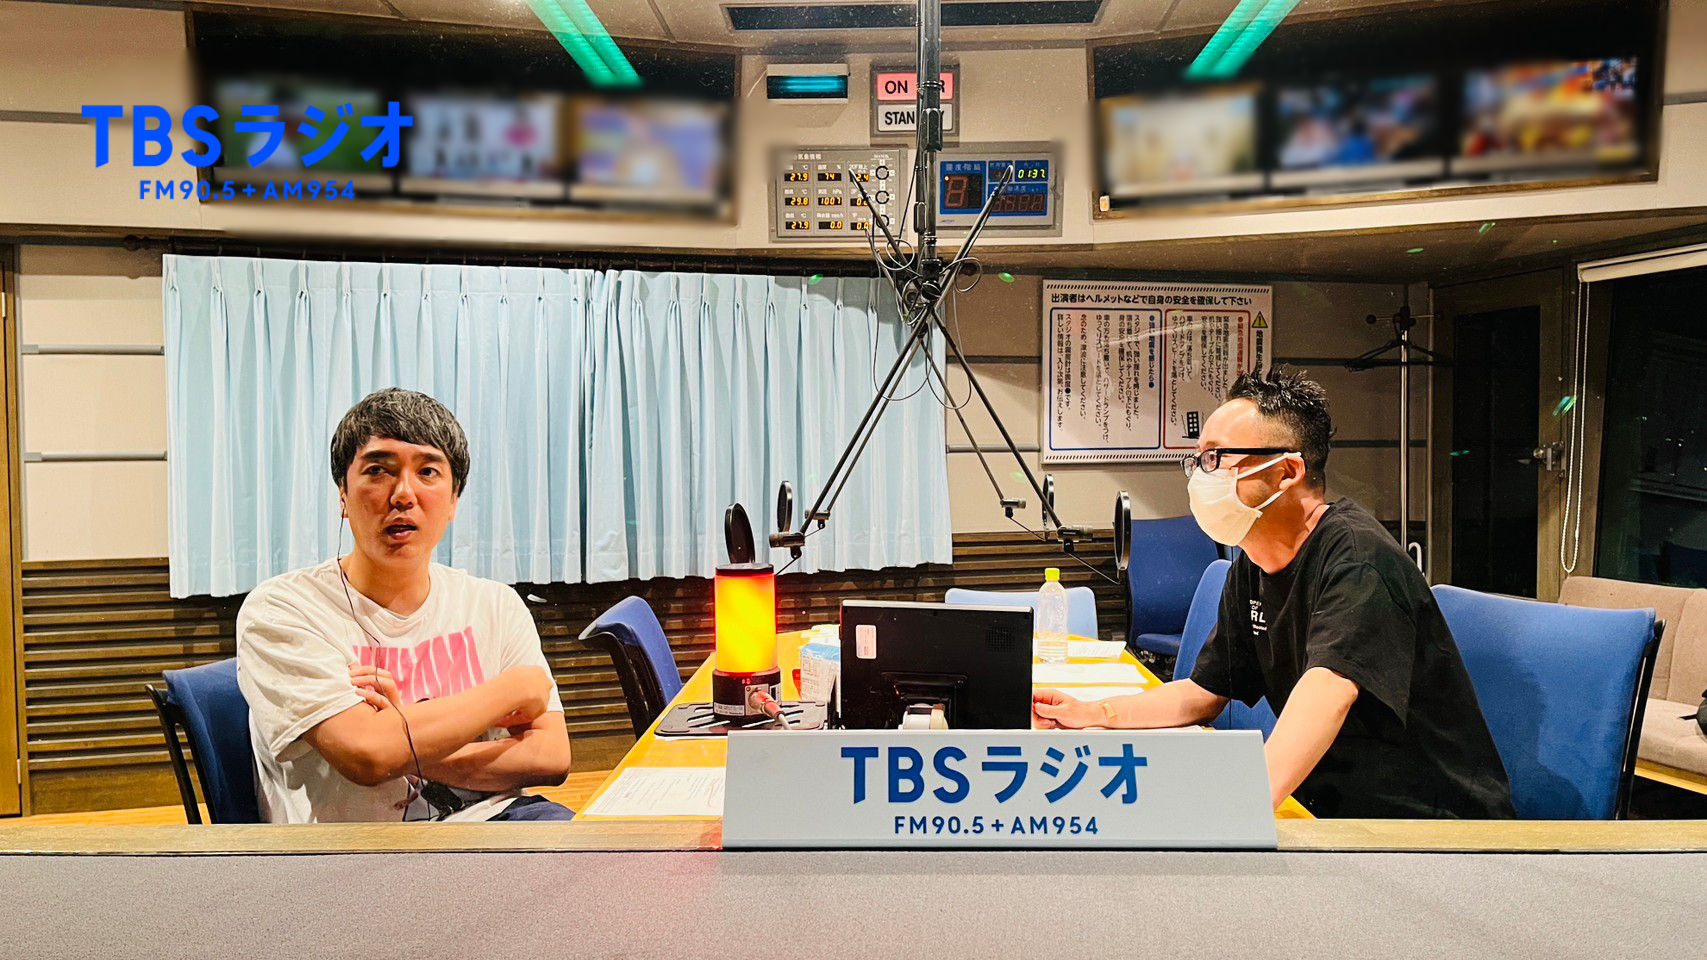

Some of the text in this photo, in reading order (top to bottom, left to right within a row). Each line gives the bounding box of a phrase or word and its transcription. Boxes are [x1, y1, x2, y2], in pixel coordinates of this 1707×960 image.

[885, 80, 908, 94] ON
[1051, 292, 1252, 306] 出演者はヘルメットなどで自身の安全を確保して下さい
[840, 743, 1149, 805] TBSラジオ
